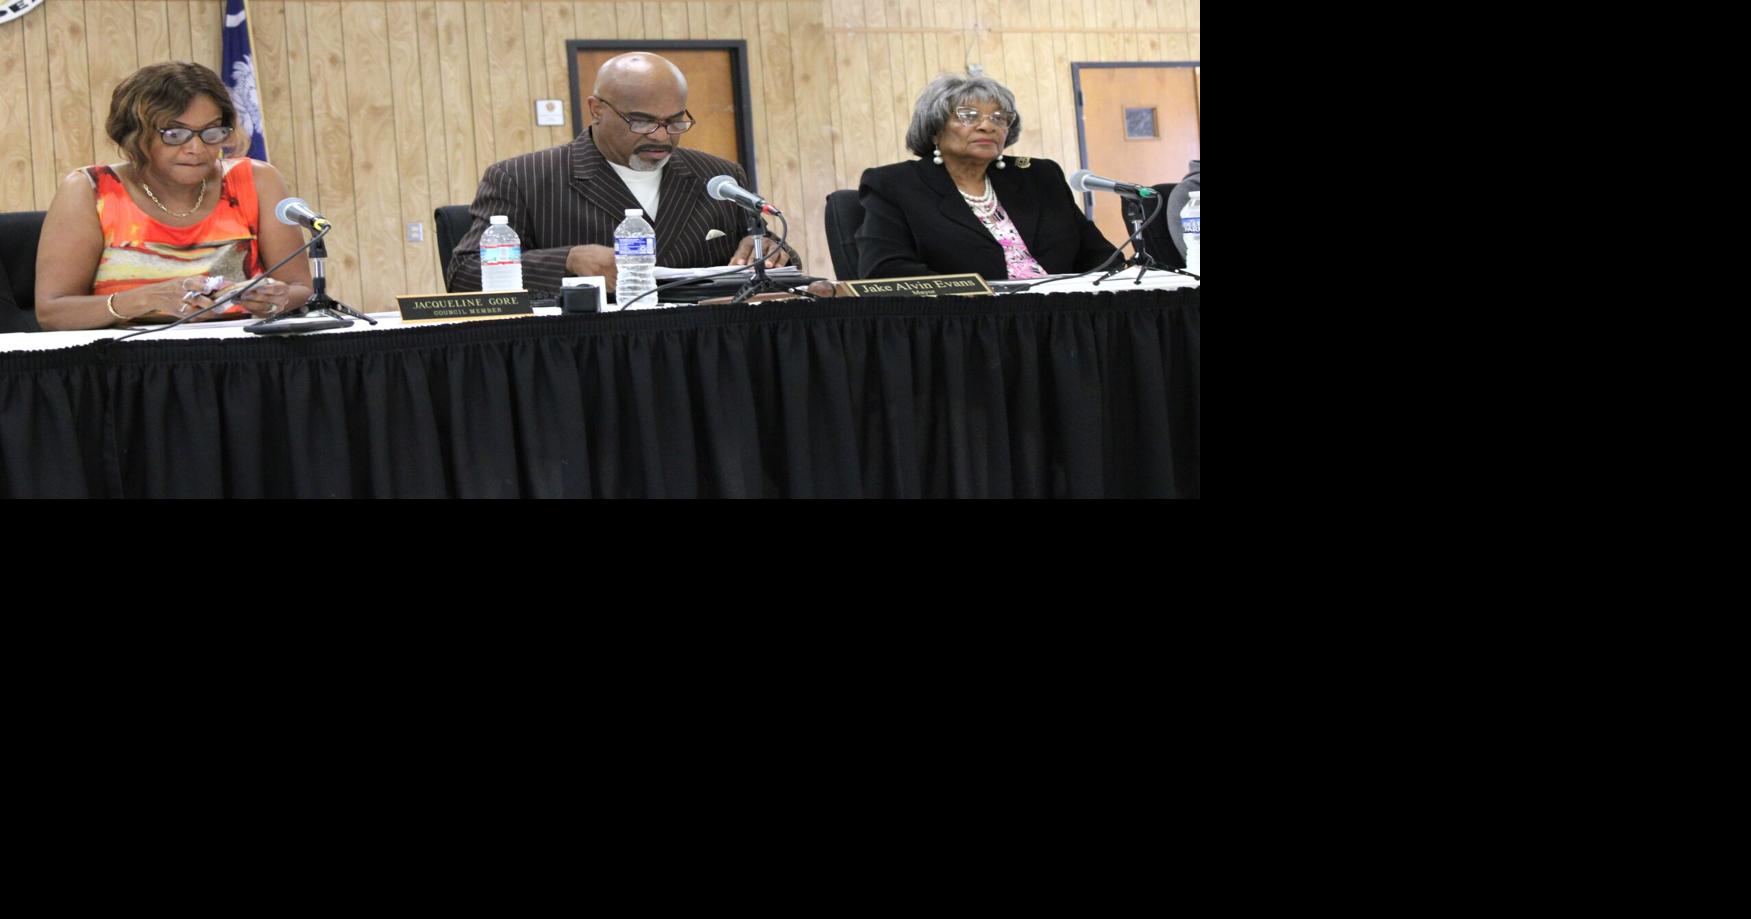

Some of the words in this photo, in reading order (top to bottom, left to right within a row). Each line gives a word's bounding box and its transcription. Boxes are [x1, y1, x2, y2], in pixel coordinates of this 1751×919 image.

[862, 284, 893, 294] Jake
[896, 280, 933, 291] Alvin
[935, 279, 975, 289] Evans
[413, 298, 482, 310] JACQUELINE
[488, 296, 519, 306] GORE
